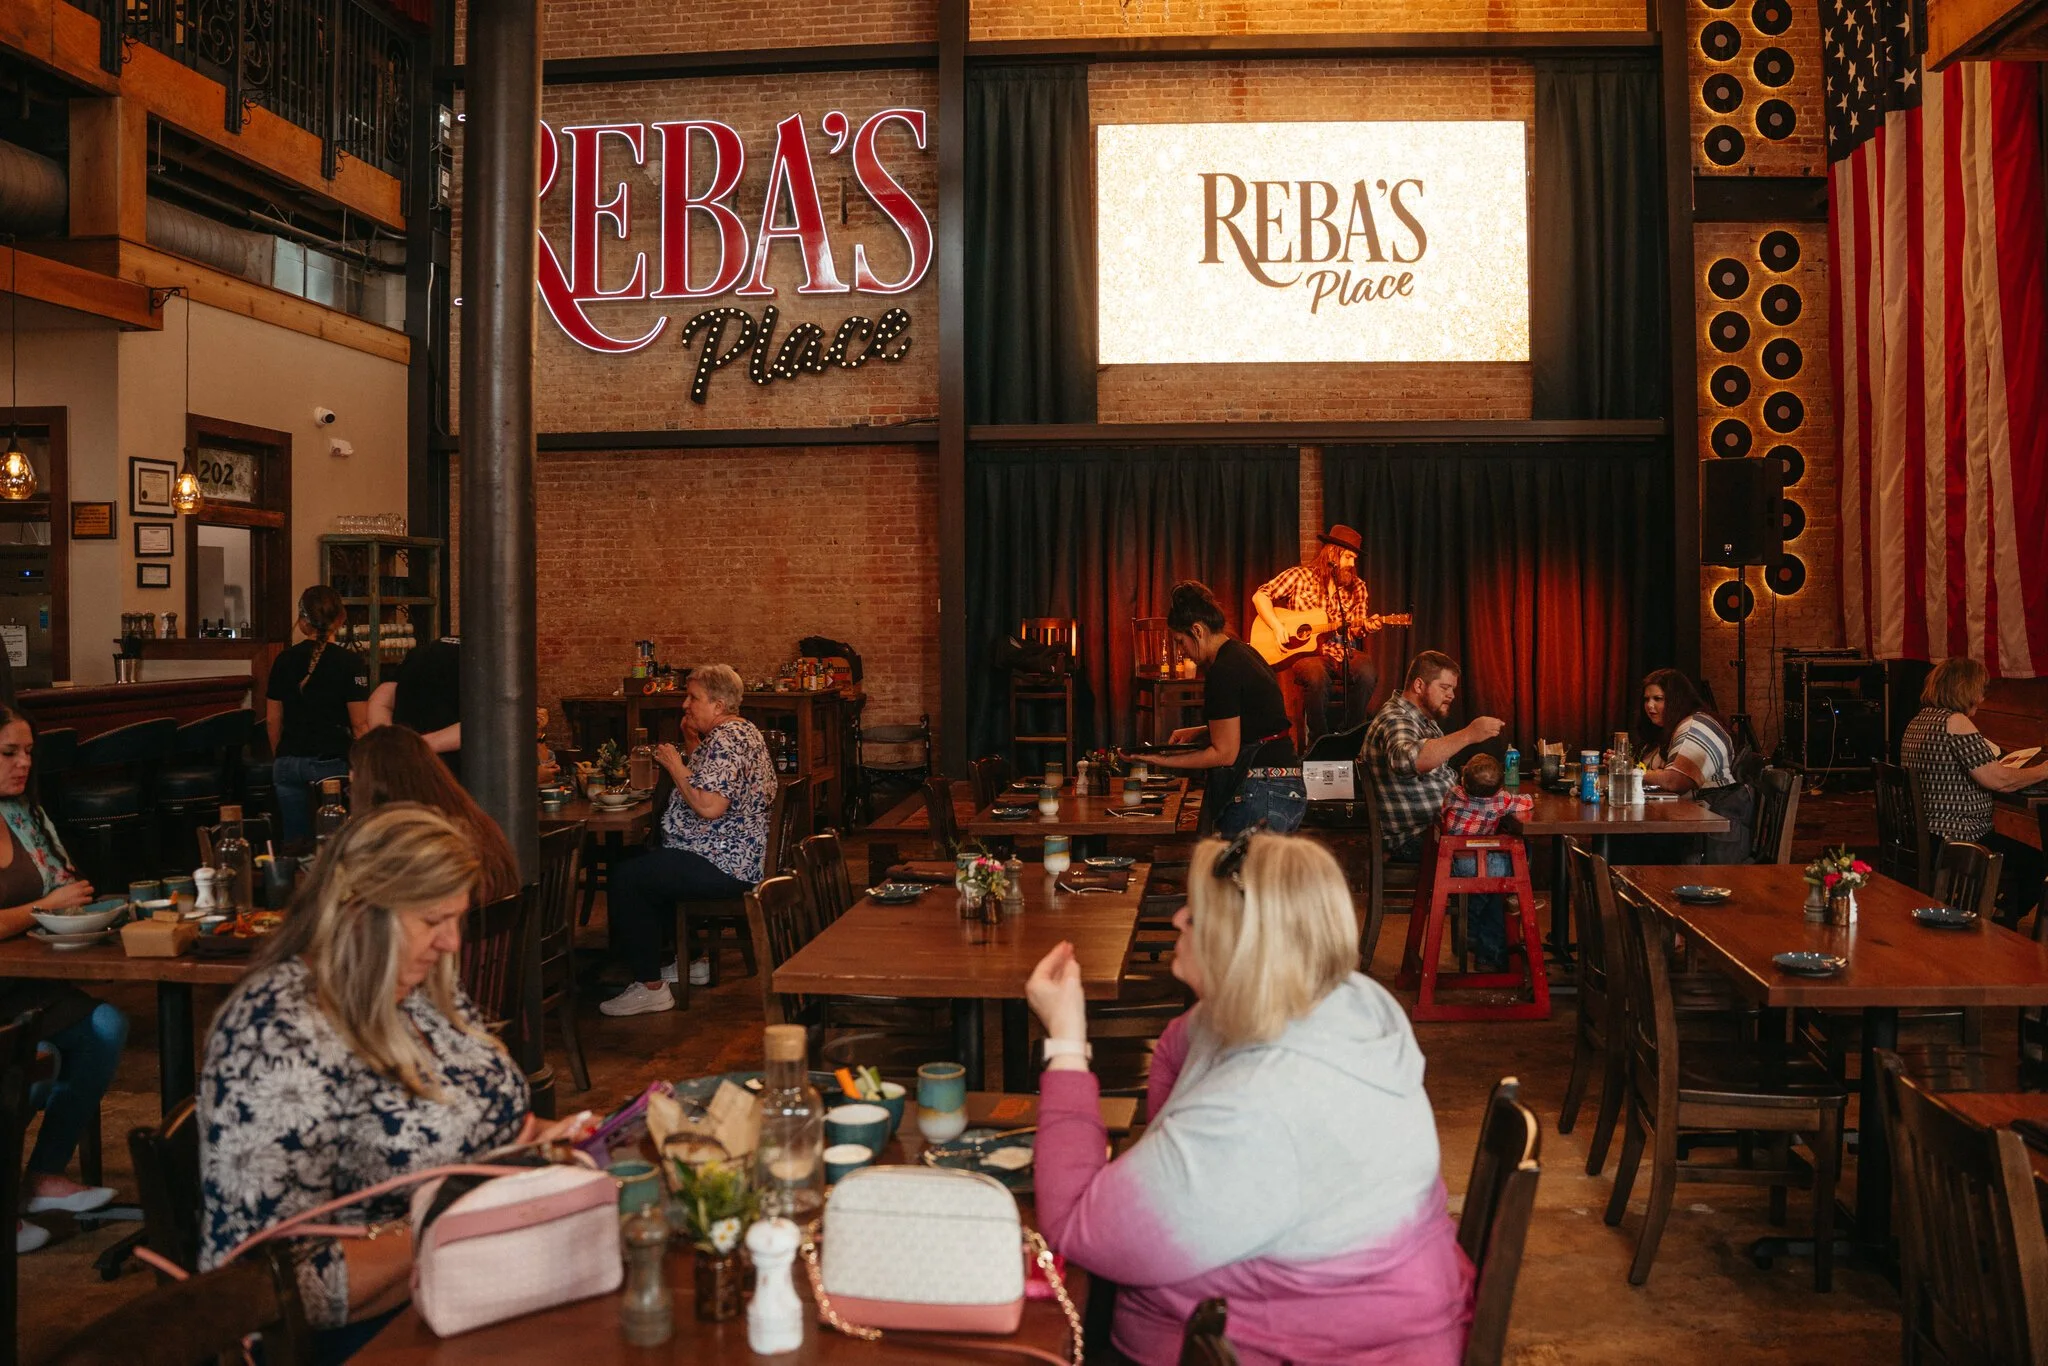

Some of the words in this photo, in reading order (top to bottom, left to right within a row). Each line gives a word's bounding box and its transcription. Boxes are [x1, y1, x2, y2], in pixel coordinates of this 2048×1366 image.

[1198, 173, 1428, 288] REBA'S
[1306, 270, 1414, 315] Place
[682, 305, 912, 404] Place
[198, 459, 233, 486] 202
